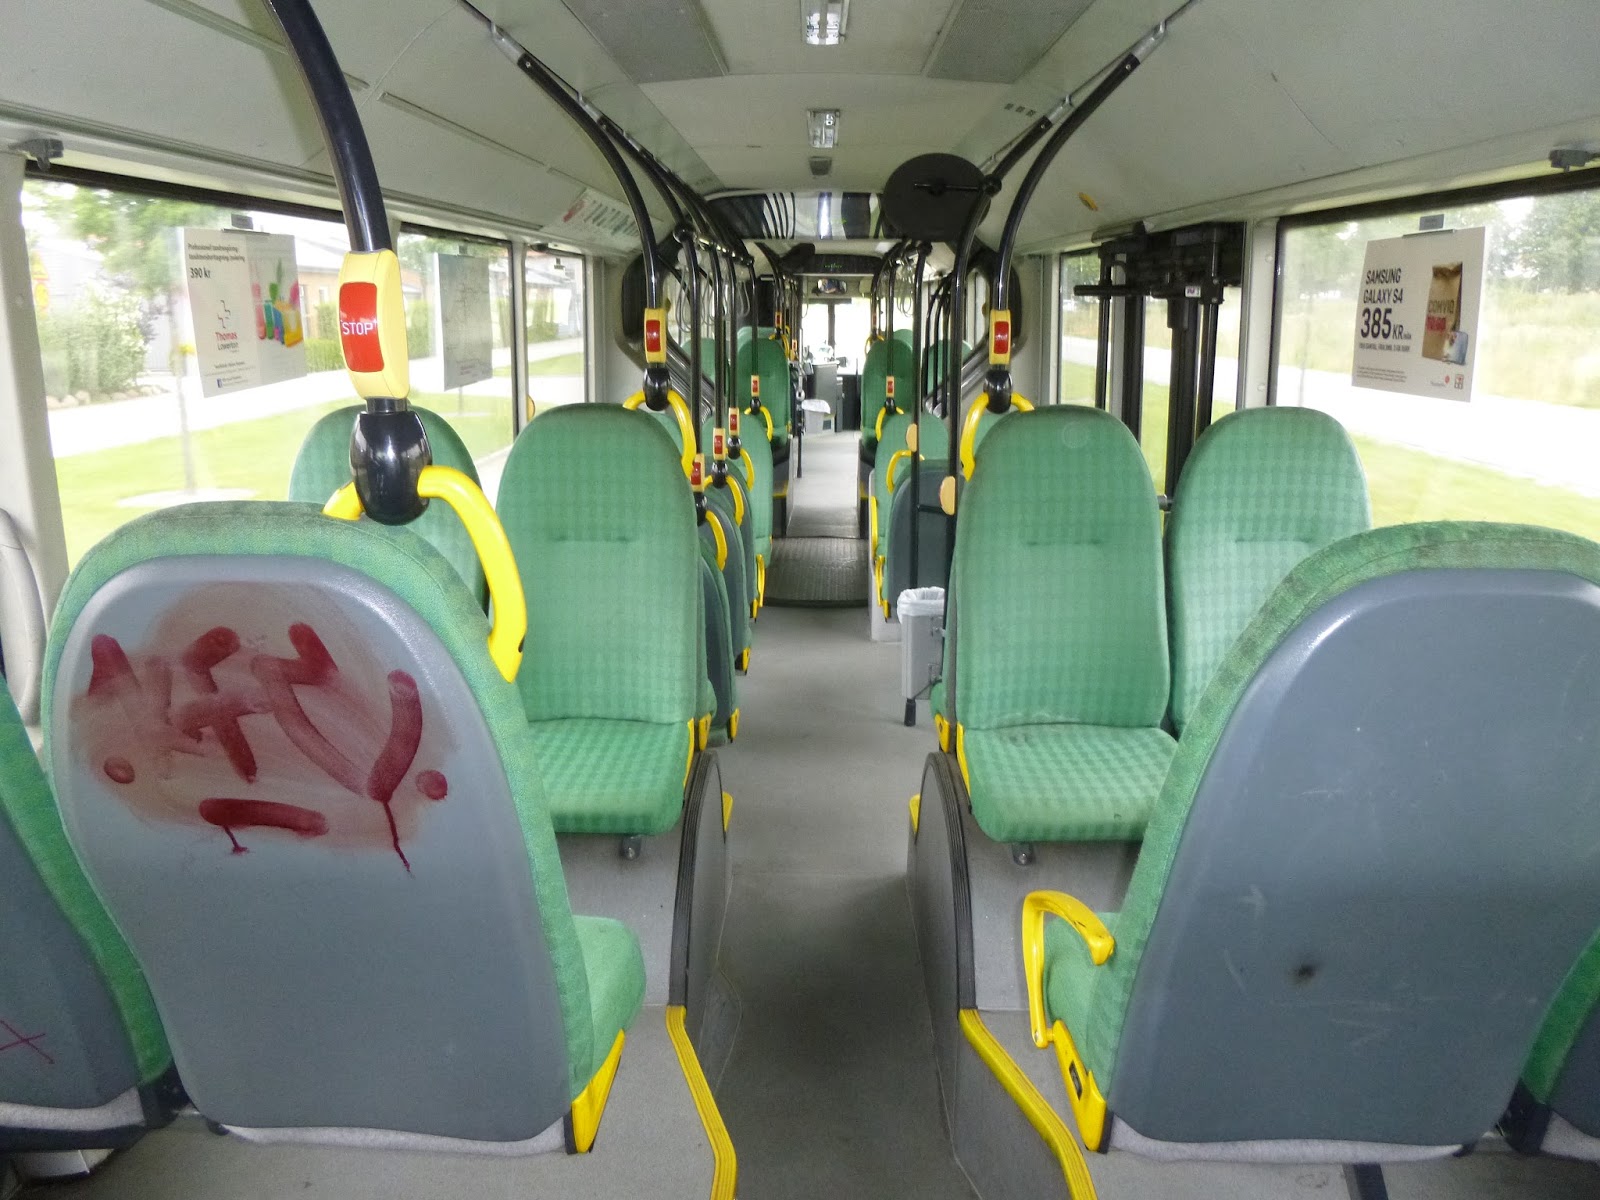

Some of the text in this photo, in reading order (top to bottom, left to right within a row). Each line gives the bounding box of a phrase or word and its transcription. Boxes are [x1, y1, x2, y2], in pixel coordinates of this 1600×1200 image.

[190, 267, 211, 279] 390 kr
[1366, 267, 1402, 285] SAMSUNG
[1363, 288, 1404, 304] GALAXY S4
[342, 322, 373, 335] STOP
[1361, 307, 1404, 339] 385 KR
[215, 331, 238, 341] Thomas
